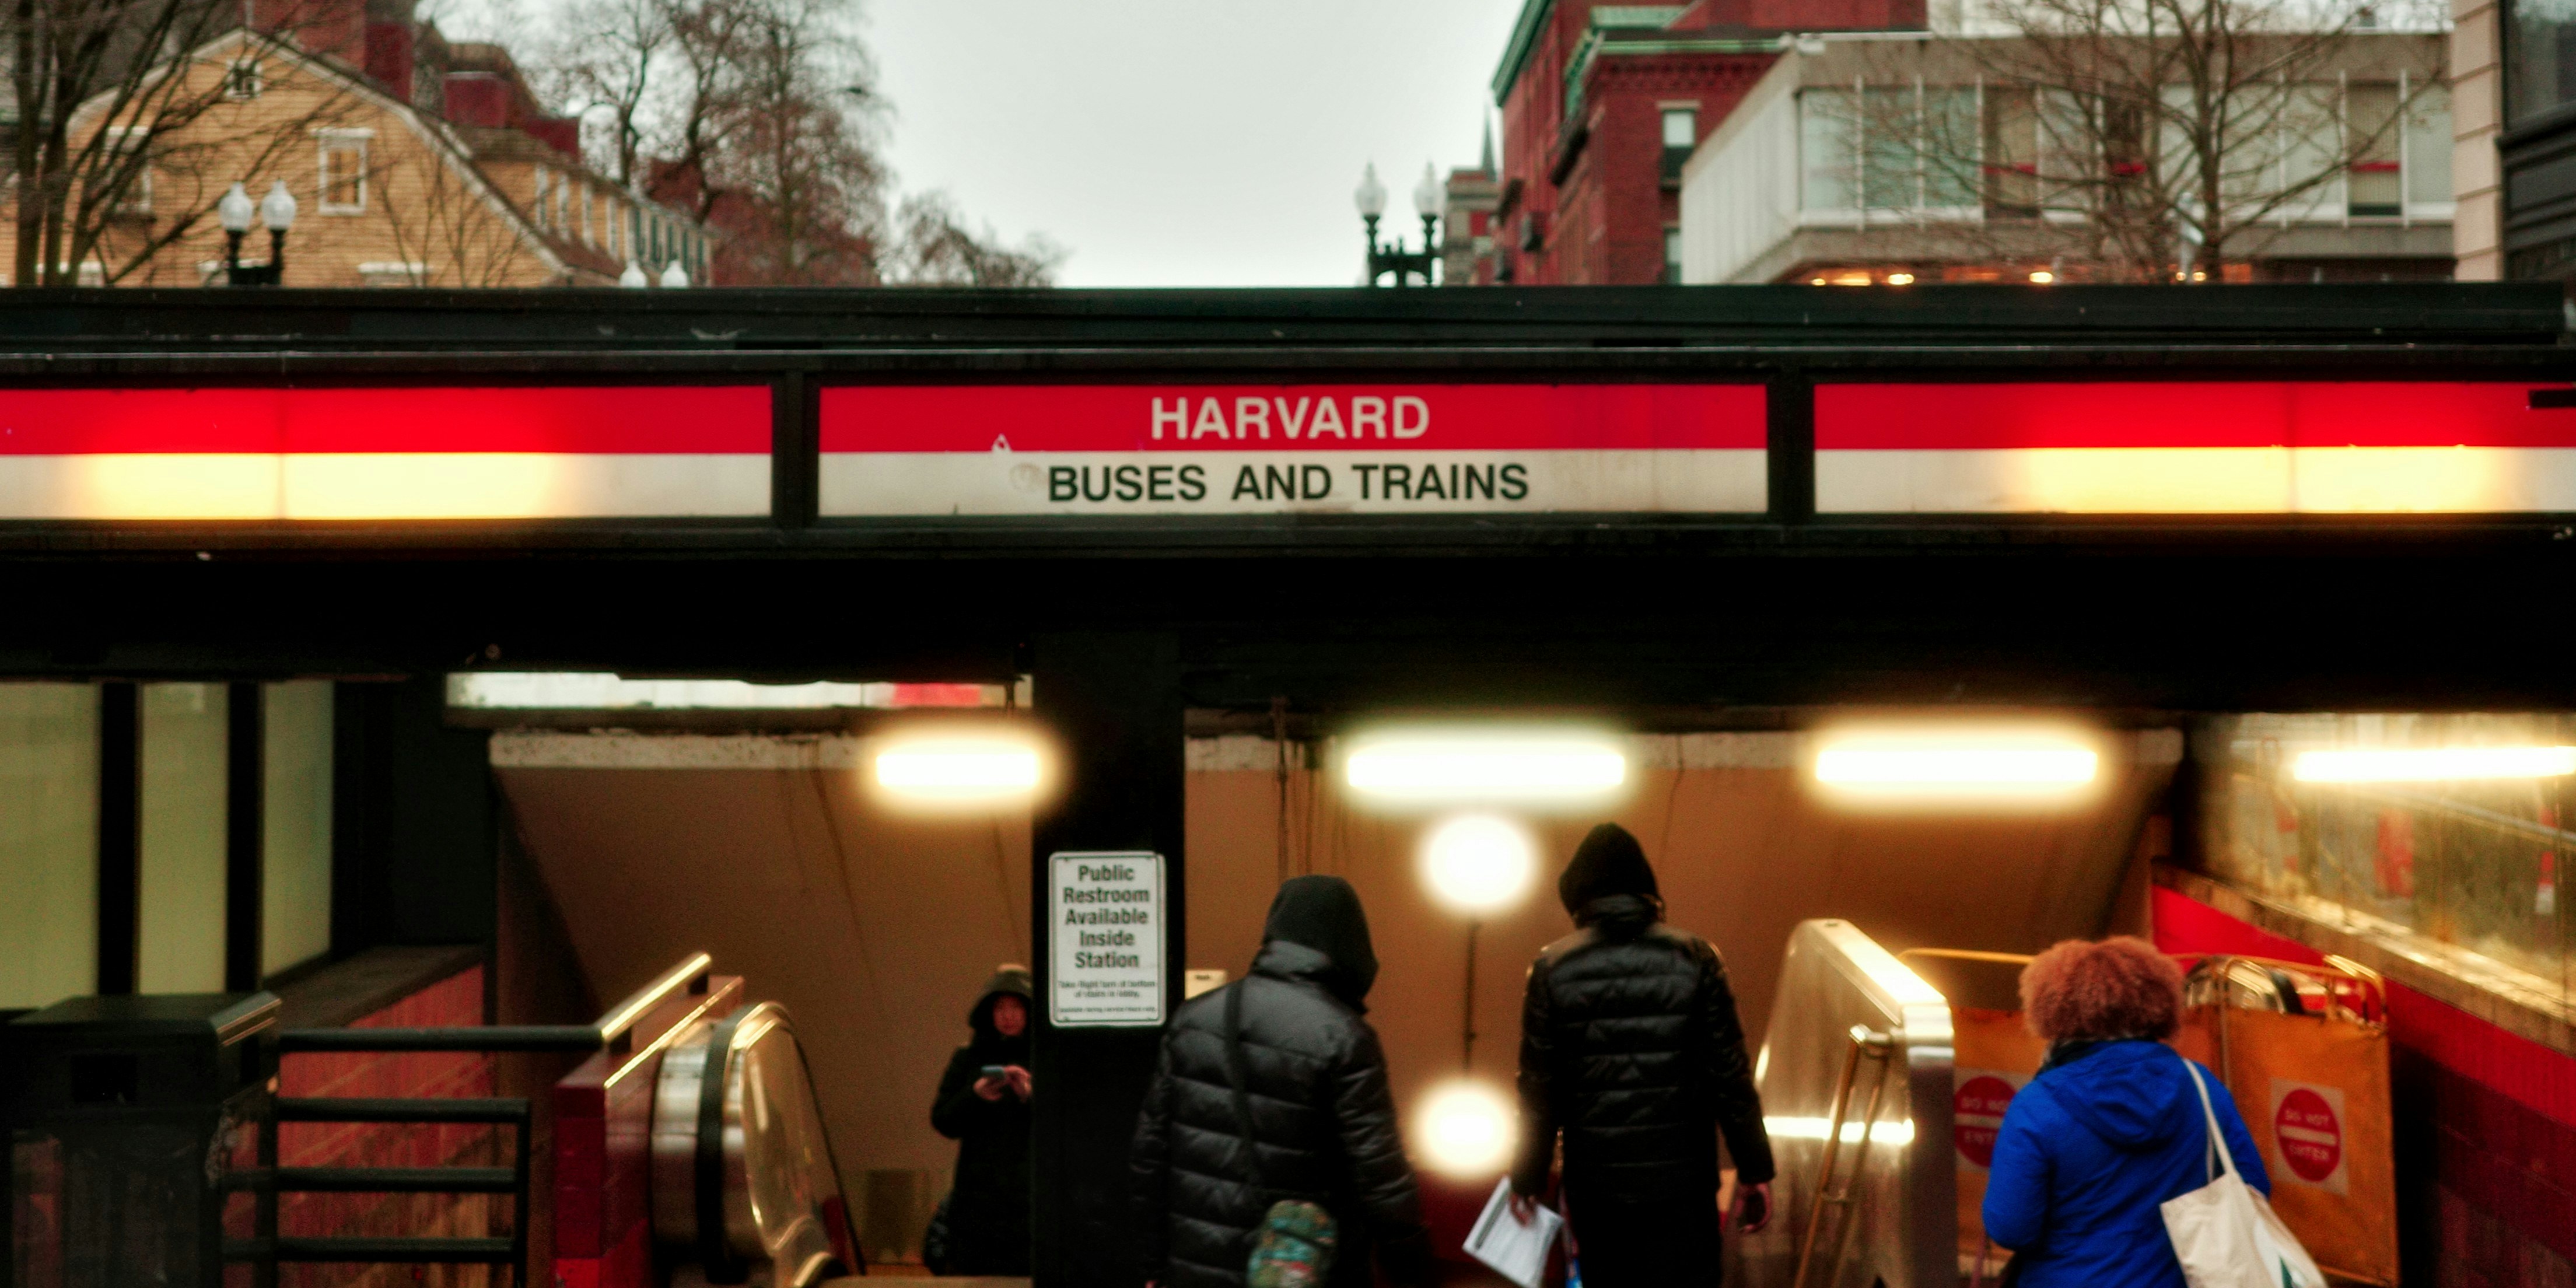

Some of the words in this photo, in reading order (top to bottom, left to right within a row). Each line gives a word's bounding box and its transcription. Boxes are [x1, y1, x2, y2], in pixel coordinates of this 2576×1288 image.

[1150, 396, 1431, 440] HARVARD
[1048, 464, 1207, 502] BUSES
[1230, 464, 1332, 501] AND
[1351, 463, 1530, 500] TRAINS
[1078, 864, 1135, 881] Public
[1063, 887, 1150, 904] Restroom
[1065, 908, 1149, 925] Available
[1080, 930, 1135, 946] Inside
[1074, 951, 1140, 969] Station
[1961, 1097, 1982, 1110] DO
[1986, 1099, 2009, 1113] NO
[2285, 1108, 2302, 1122] DO
[2305, 1113, 2330, 1126] NOT
[2288, 1143, 2330, 1161] ENTER
